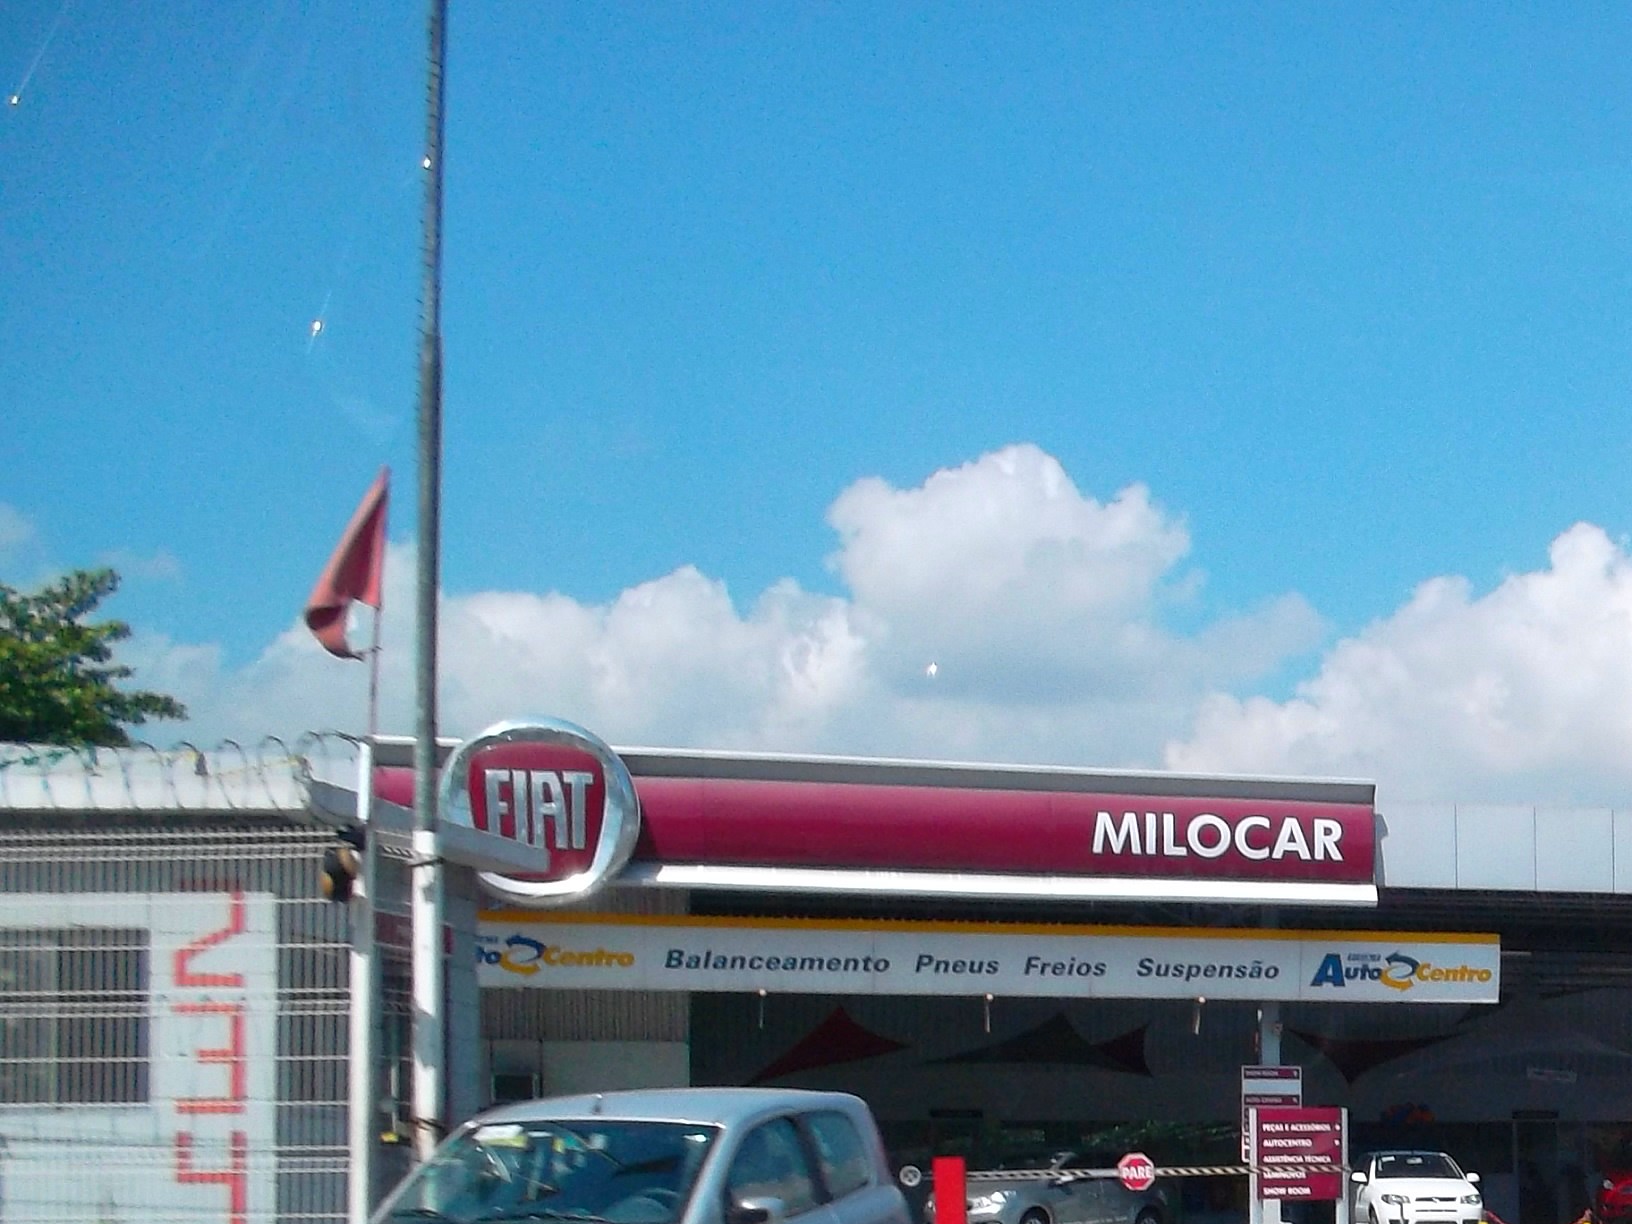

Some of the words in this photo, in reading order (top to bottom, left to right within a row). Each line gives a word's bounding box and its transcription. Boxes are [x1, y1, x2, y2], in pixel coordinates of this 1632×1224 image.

[484, 768, 594, 850] FIAT
[1092, 811, 1344, 861] MILOCAR
[544, 944, 636, 967] Centro
[665, 949, 890, 973] Balanceamento
[915, 954, 999, 975] Pneus
[1024, 956, 1107, 978] Freios
[1136, 957, 1280, 982] Suspensão
[1416, 962, 1492, 983] Centro
[1263, 1139, 1312, 1147] AUTOCENTRO
[1122, 1165, 1153, 1180] PARE
